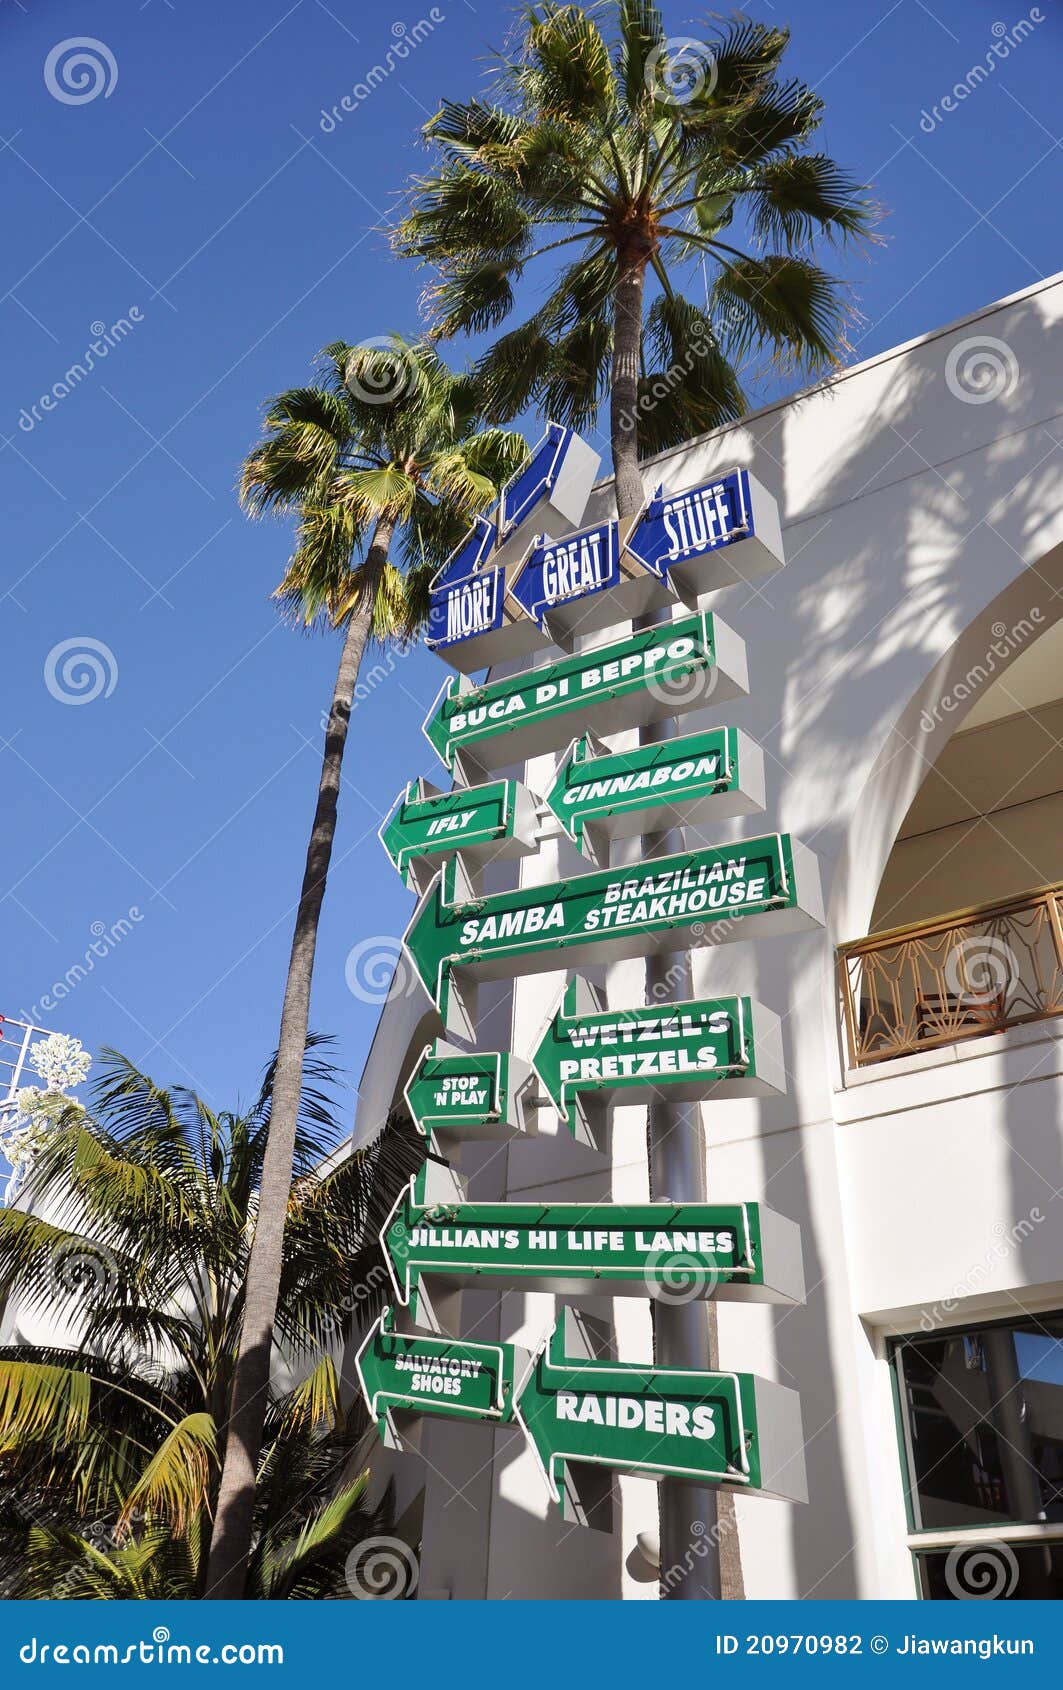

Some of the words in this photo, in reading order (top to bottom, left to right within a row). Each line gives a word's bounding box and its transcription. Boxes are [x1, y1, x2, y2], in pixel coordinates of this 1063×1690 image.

[663, 484, 731, 560] STUFF
[542, 533, 604, 605] GREAT
[447, 577, 491, 643] MORE
[449, 698, 527, 733] BUCA
[536, 681, 570, 704] DI
[580, 637, 696, 690] BEPPO
[562, 757, 717, 806] CINNABON
[426, 810, 478, 837] IFLY
[604, 857, 746, 903] BRAZILIAN
[459, 902, 566, 946] SAMBA
[584, 878, 766, 931] STEAKHOUSE
[567, 1011, 730, 1049] WETZEL'S
[442, 1076, 479, 1091] STOP
[559, 1046, 719, 1081] PRETZELS
[452, 1090, 487, 1106] PLAY
[408, 1229, 519, 1250] JILLIAN'S
[528, 1230, 558, 1250] HI
[567, 1230, 625, 1251] LIFE
[634, 1231, 735, 1254] LANES
[394, 1353, 483, 1379] SALVATORY
[410, 1373, 462, 1396] SHOES
[555, 1390, 717, 1440] RAIDERS
